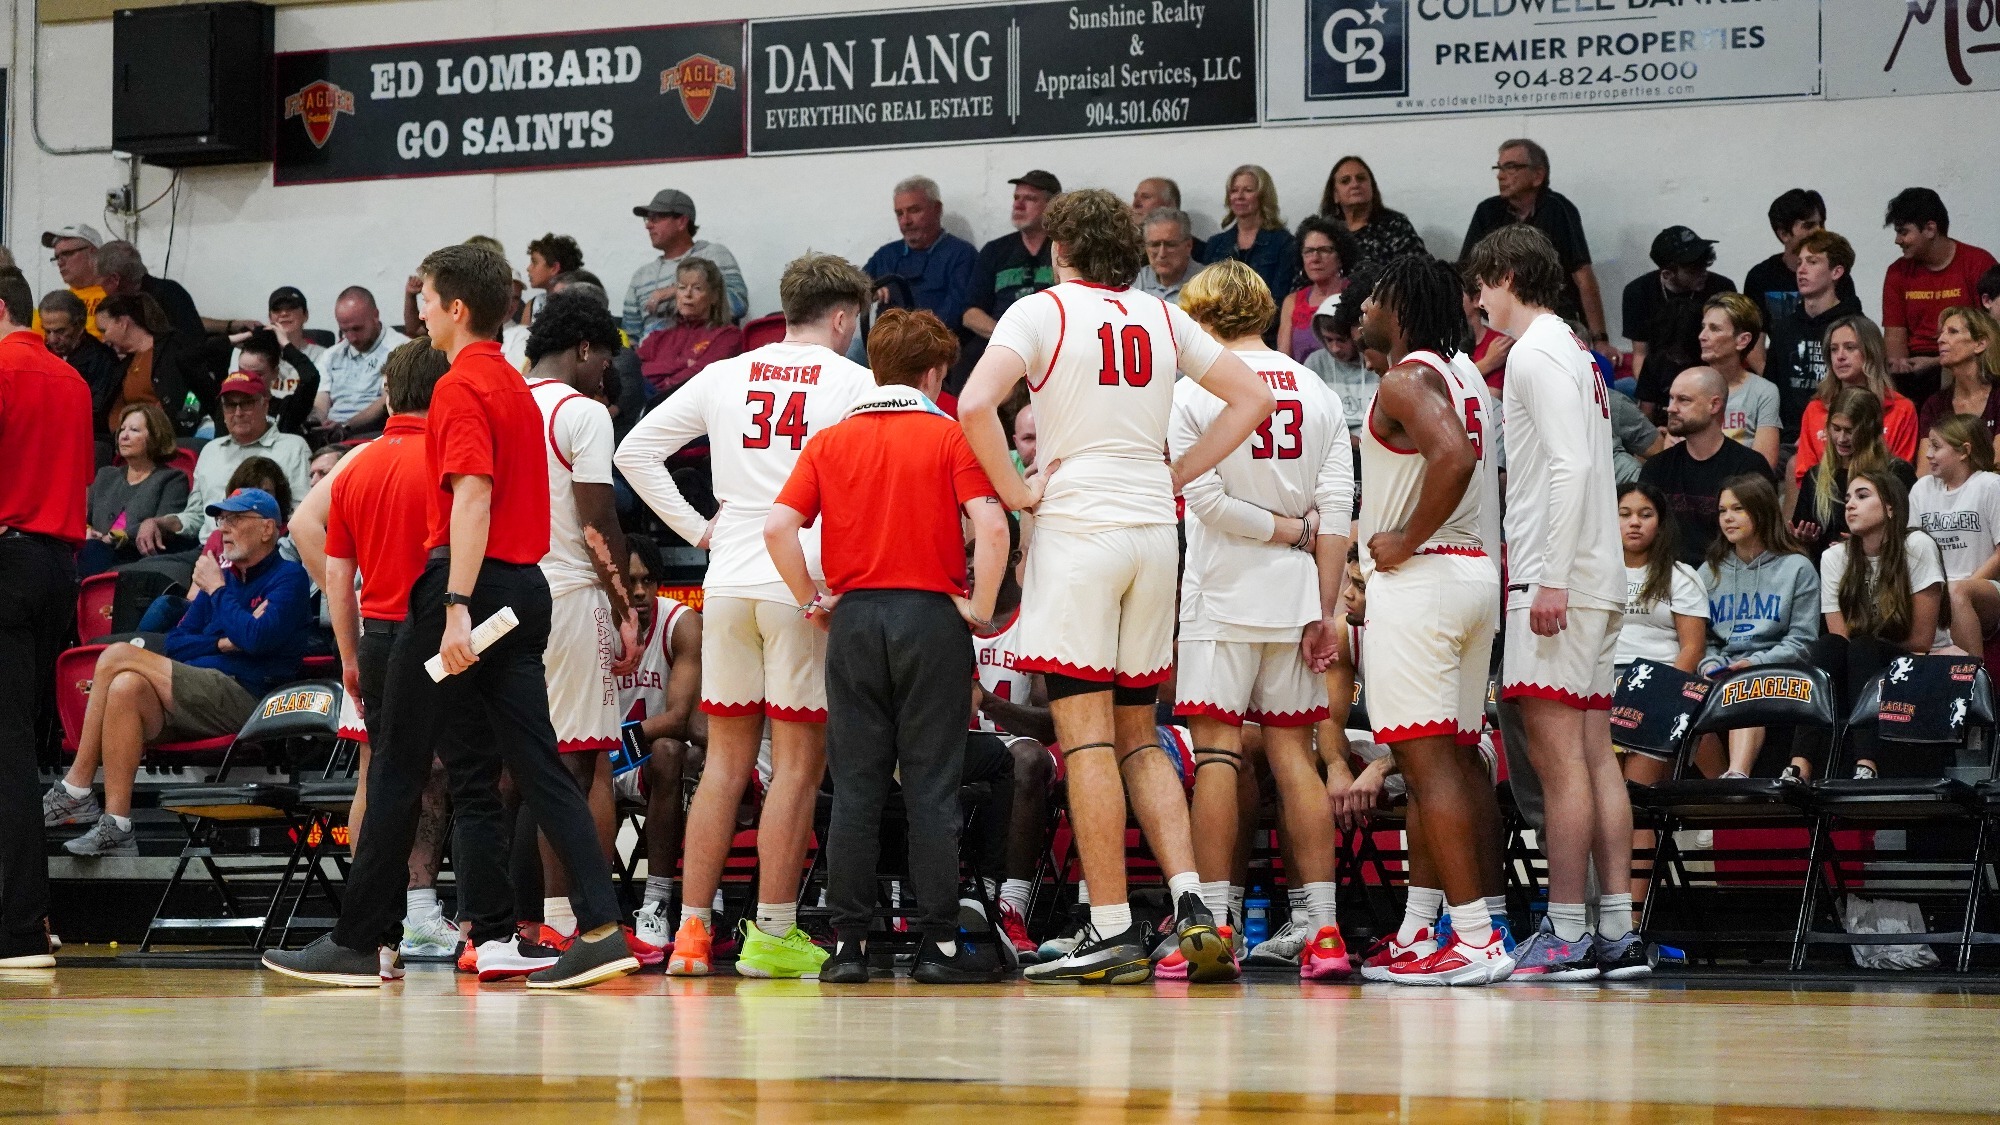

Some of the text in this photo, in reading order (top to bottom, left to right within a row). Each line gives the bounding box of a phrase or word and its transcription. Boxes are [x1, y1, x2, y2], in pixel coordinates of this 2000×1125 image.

[1068, 0, 1206, 30] Sunshine Realty
[765, 30, 992, 94] DAN LANG
[1130, 34, 1144, 56] &
[1436, 38, 1567, 65] PREMIER
[370, 45, 642, 99] ED LOMBARD
[661, 65, 735, 92] FLAGLER
[1034, 56, 1241, 100] Appraisal Services, LLC
[1495, 61, 1698, 89] 904-824-5000
[766, 96, 993, 131] EVERYTHING REAL ESTATE
[1085, 97, 1190, 127] 904.501.6867
[397, 109, 614, 160] GO SAINTS
[1097, 322, 1153, 387] 10
[749, 361, 822, 385] WEBSTER
[743, 390, 808, 451] 34
[1252, 400, 1303, 460] 33
[1709, 592, 1781, 626] MIAMI
[593, 607, 616, 706] SAINTS
[1722, 677, 1813, 707] FLAGLER
[1879, 701, 1916, 715] LAGLER
